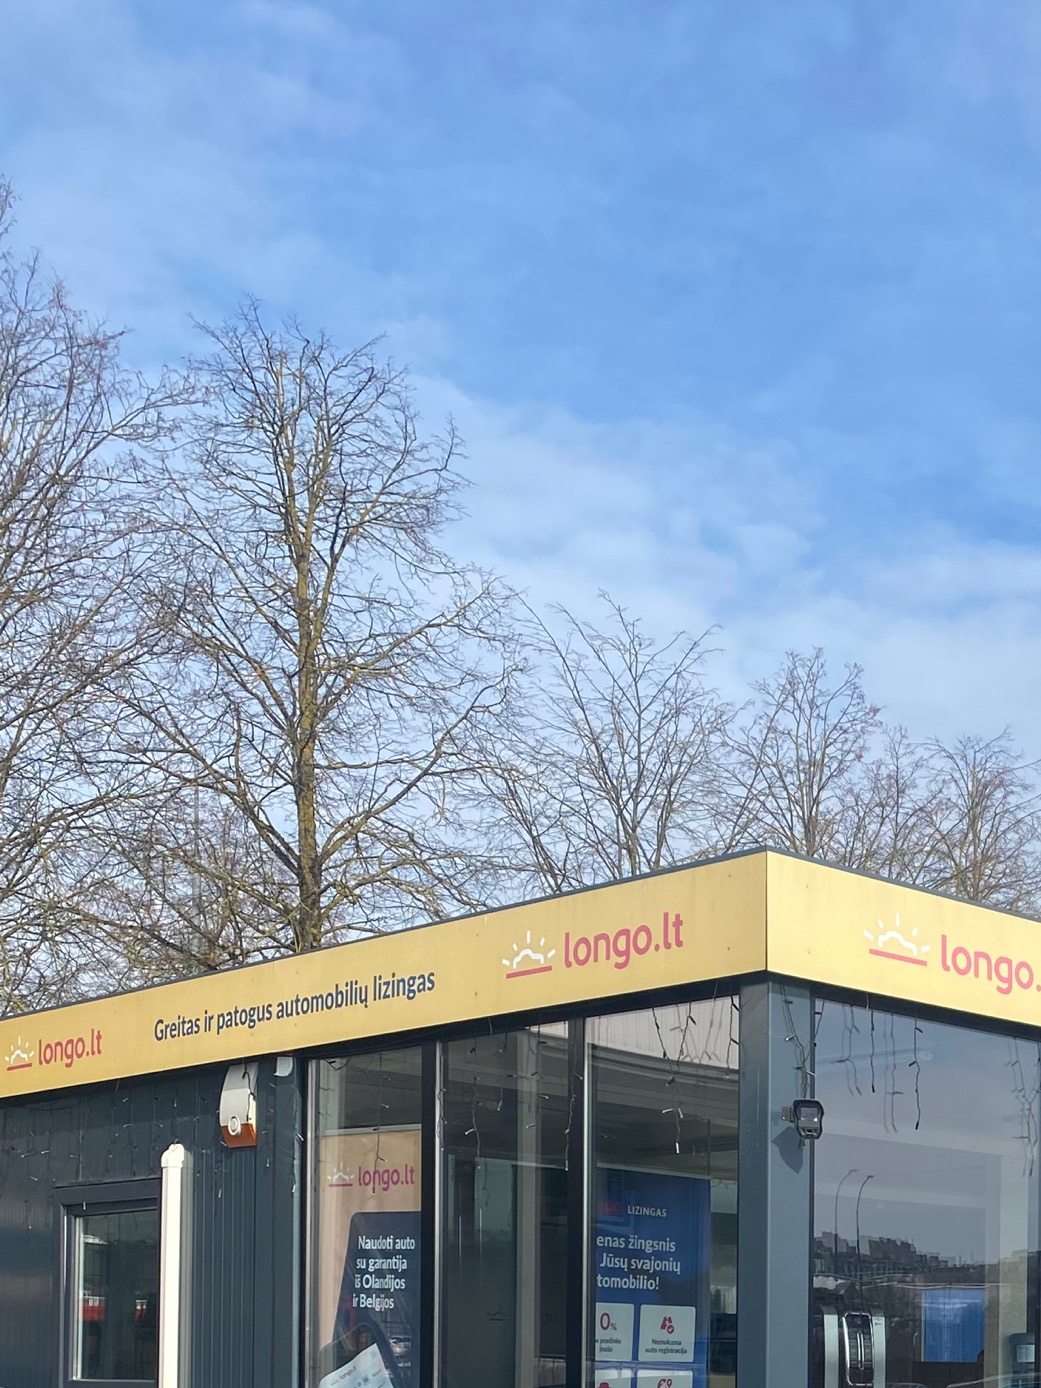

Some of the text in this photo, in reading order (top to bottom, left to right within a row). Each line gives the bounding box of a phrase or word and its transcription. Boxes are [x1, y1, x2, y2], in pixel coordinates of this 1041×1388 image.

[563, 911, 684, 970] longo.lt
[154, 971, 435, 1041] Greitas ir patogus automobilių lizingas
[38, 1030, 102, 1067] longo.lt
[358, 1164, 415, 1191] longo.lt
[627, 1205, 667, 1217] LIZINGAS
[358, 1235, 415, 1250] Naudoti auto
[596, 1234, 676, 1254] enas žingsnis
[356, 1254, 407, 1272] su garantija
[600, 1252, 681, 1275] Jūsų svajonių
[362, 1274, 405, 1292] Olandijos
[596, 1273, 660, 1290] tomobilio!
[352, 1293, 394, 1312] ir Belgijos
